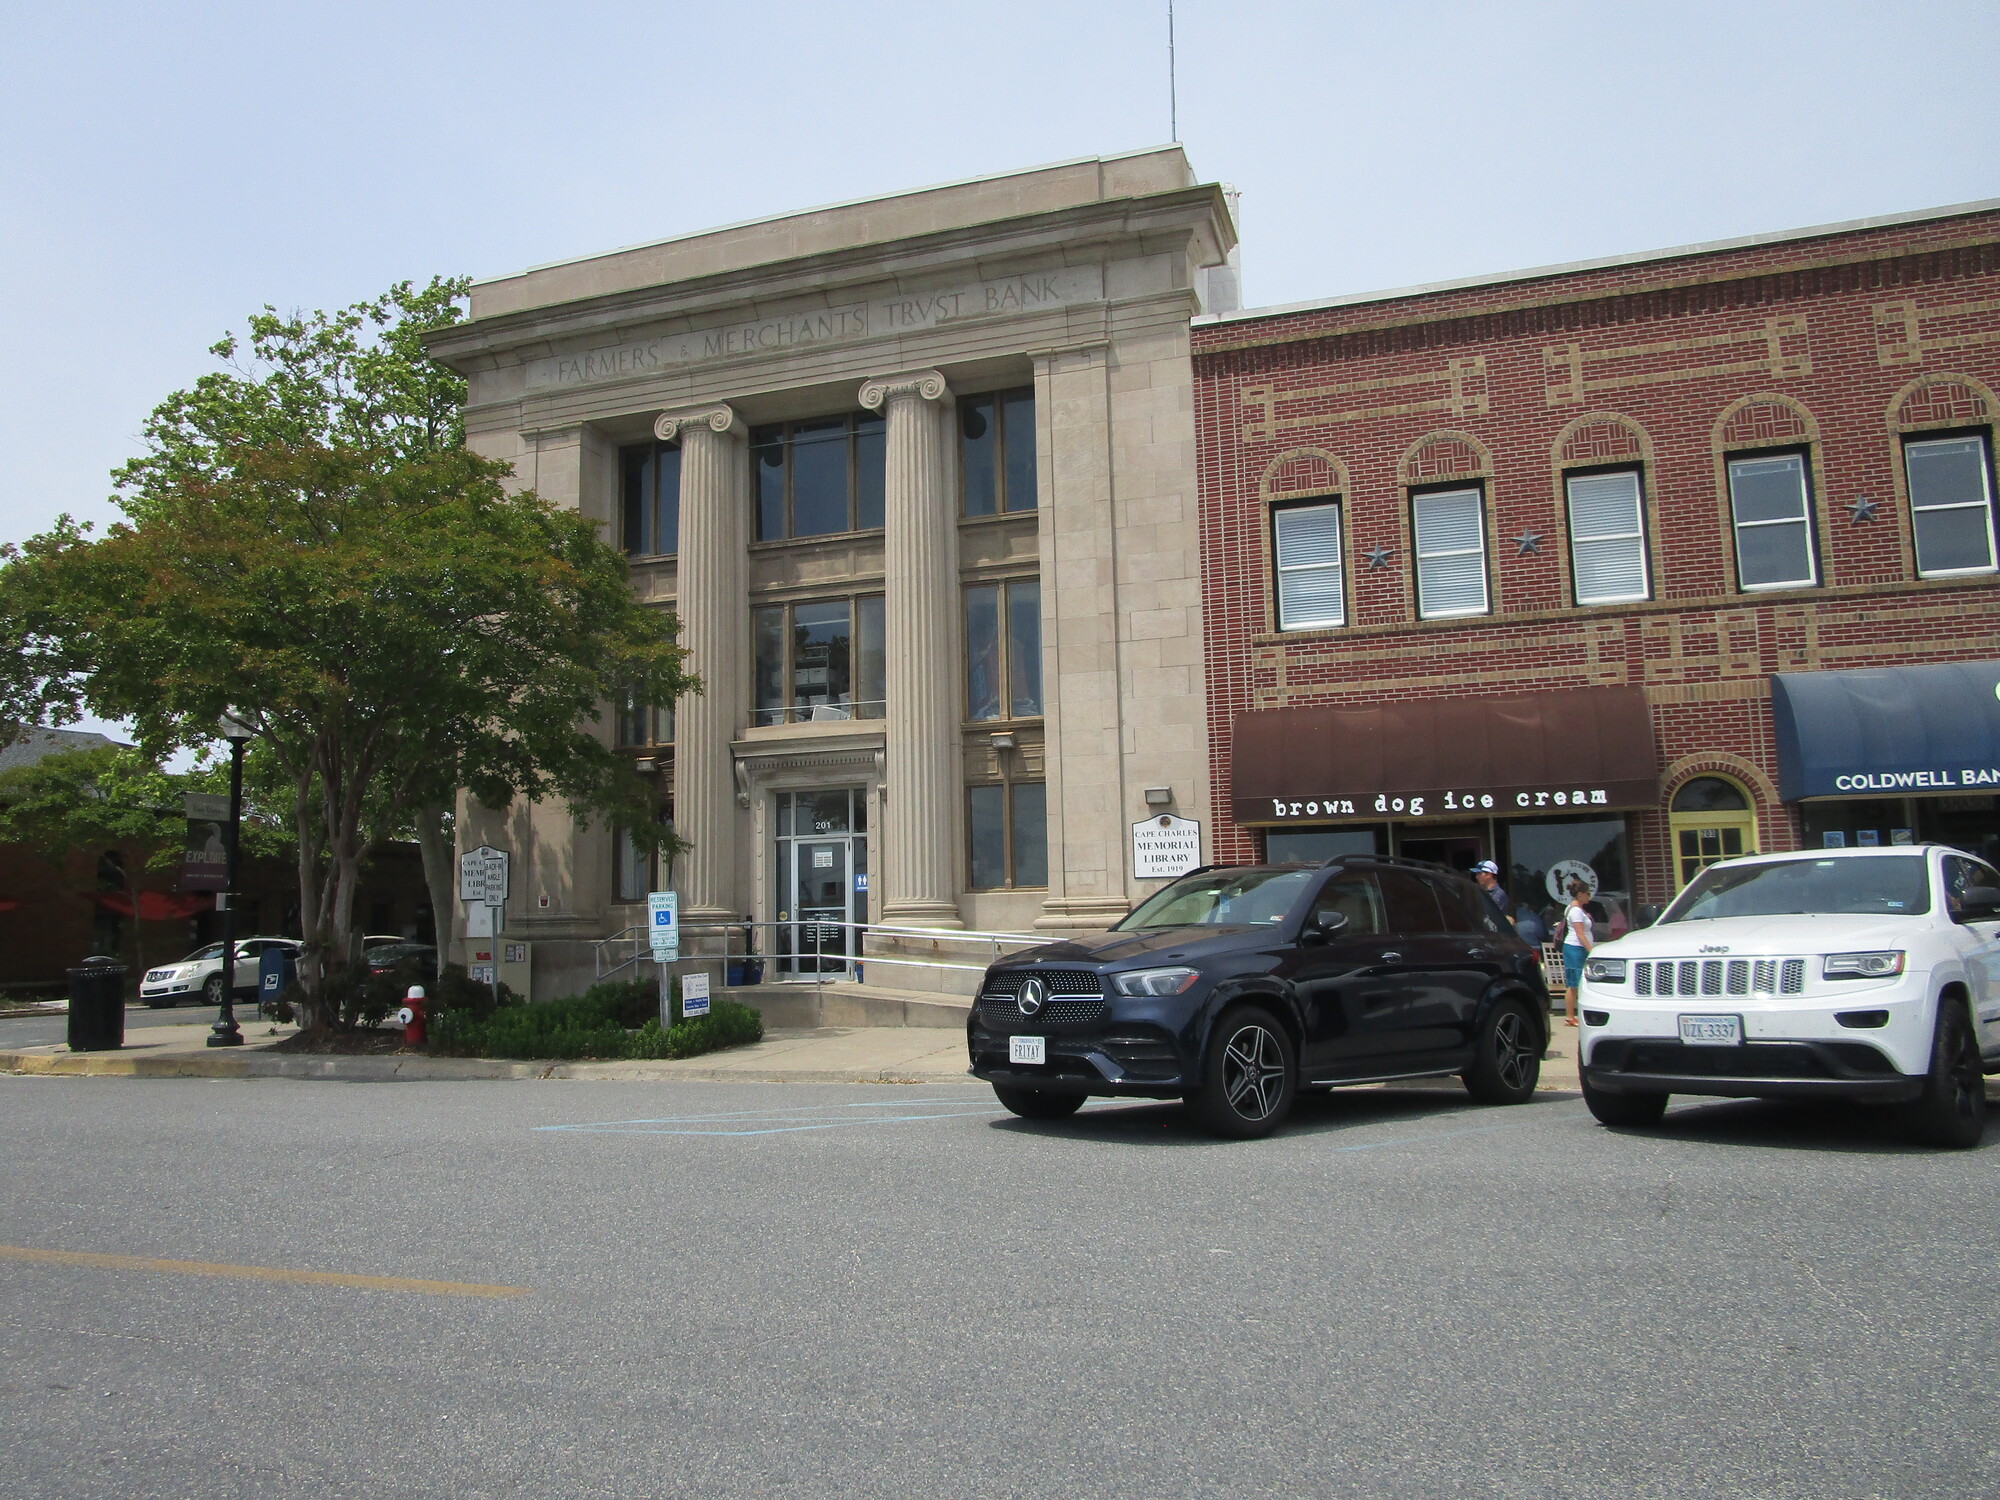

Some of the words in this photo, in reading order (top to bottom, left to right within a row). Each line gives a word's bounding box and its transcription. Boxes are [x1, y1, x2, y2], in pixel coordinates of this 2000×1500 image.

[559, 344, 659, 382] FARMERS
[680, 344, 689, 358] &
[704, 308, 865, 358] MERCHANTS
[985, 276, 1061, 311] BANK
[1836, 770, 1956, 790] COLDWELL
[1273, 799, 1355, 816] brown
[1374, 794, 1424, 816] dog
[1444, 790, 1494, 809] ice
[1516, 789, 1608, 807] cream
[1158, 829, 1198, 837] CHARLES
[1138, 841, 1197, 850] MEMORIAL
[185, 850, 227, 864] EXPLORE
[1144, 853, 1190, 863] LIBRARY
[1699, 944, 1730, 954] Jeep
[1683, 1023, 1736, 1038] UZK-3337
[1015, 1044, 1040, 1057] FRIYAY
